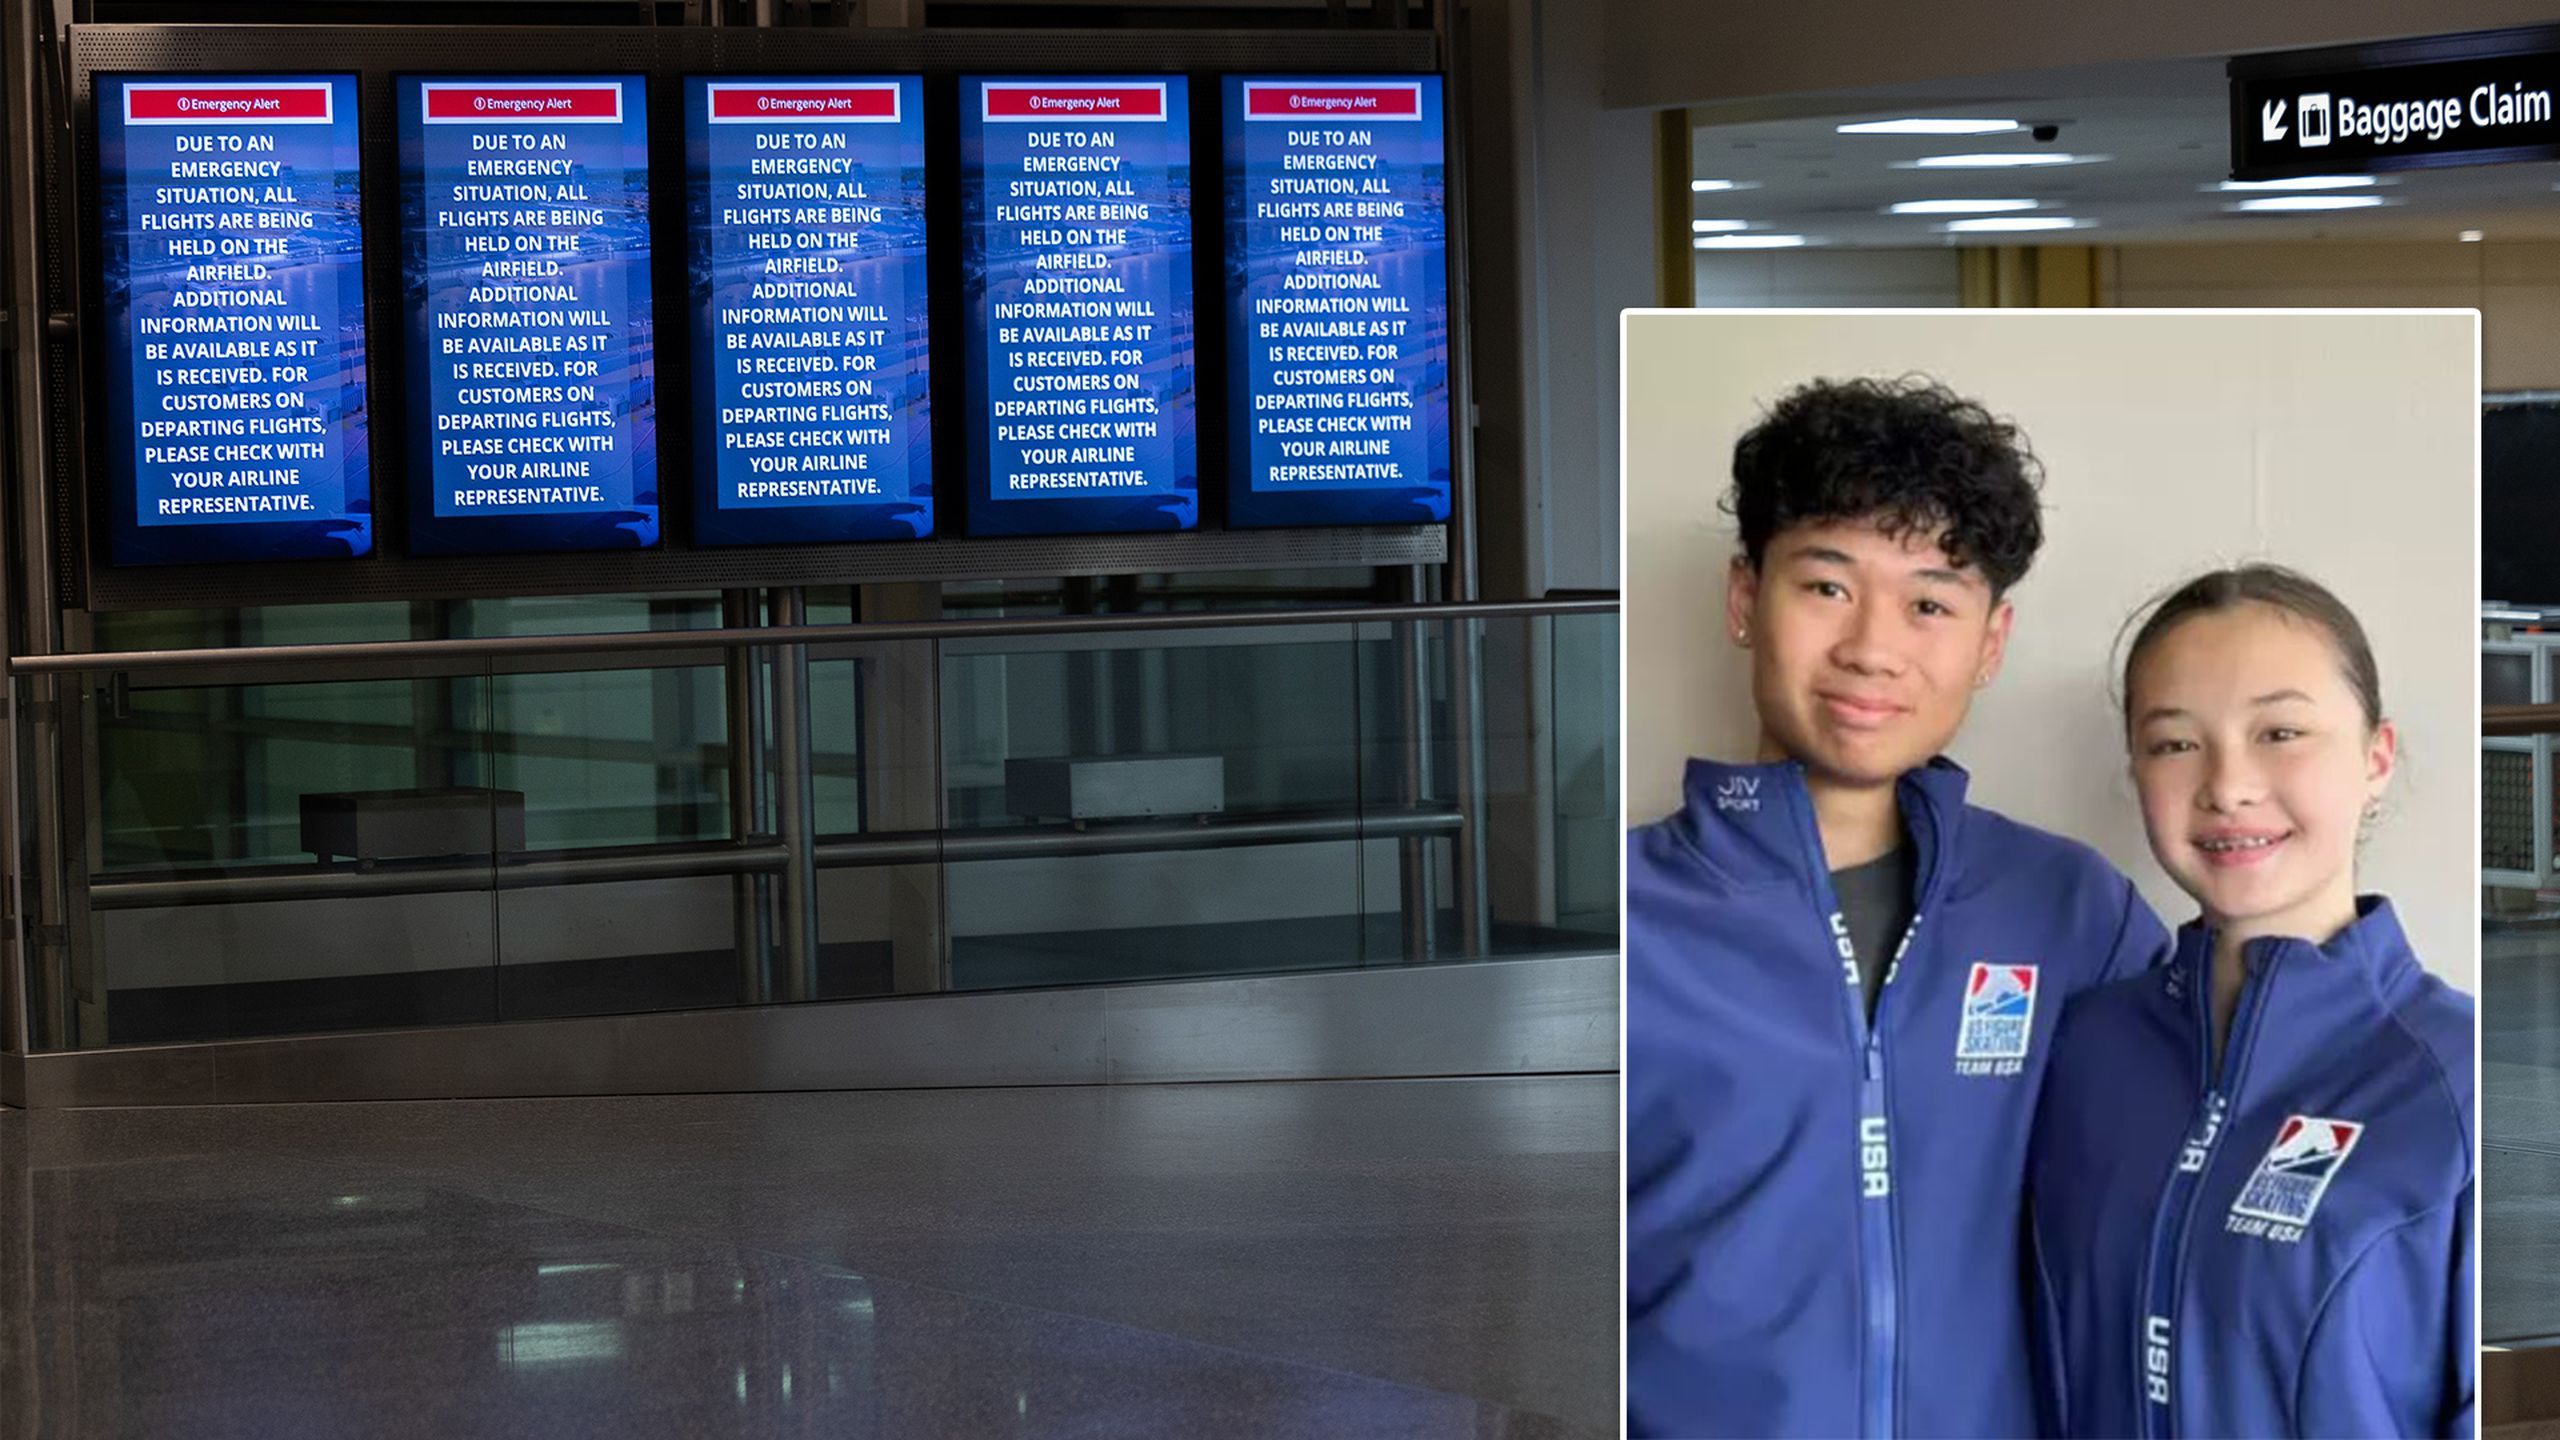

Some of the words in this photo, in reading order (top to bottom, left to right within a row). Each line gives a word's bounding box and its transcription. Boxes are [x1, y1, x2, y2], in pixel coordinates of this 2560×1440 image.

[191, 98, 252, 113] Emergency
[252, 97, 281, 110] Alert
[487, 98, 546, 113] Emergency
[546, 97, 572, 109] Alert
[770, 97, 827, 112] Emergency
[827, 97, 852, 109] Alert
[1041, 96, 1096, 111] Emergency
[1096, 96, 1121, 109] Alert
[1301, 96, 1354, 110] Emergency
[1353, 96, 1377, 108] Alert
[2338, 97, 2462, 145] Baggage
[2469, 81, 2551, 127] Claim
[176, 135, 214, 152] DUE
[217, 135, 243, 152] TO
[246, 135, 274, 152] AN
[472, 134, 508, 150] DUE
[511, 134, 536, 150] TO
[540, 134, 566, 150] AN
[171, 160, 282, 178] EMERGENCY
[467, 159, 573, 176] EMERGENCY
[751, 158, 853, 175] EMERGENCY
[1023, 156, 1121, 172] EMERGENCY
[1283, 154, 1377, 170] EMERGENCY
[156, 187, 260, 205] SITUATION,
[263, 186, 298, 203] ALL
[453, 185, 552, 203] SITUATION,
[556, 184, 588, 201] ALL
[737, 183, 833, 201] SITUATION,
[836, 182, 867, 199] ALL
[1010, 180, 1101, 198] SITUATION,
[1105, 180, 1135, 196] ALL
[1271, 178, 1359, 195] SITUATION,
[1362, 178, 1391, 194] ALL
[439, 210, 509, 227] FLIGHTS
[513, 210, 547, 226] ARE
[551, 208, 604, 226] BEING
[724, 208, 791, 225] FLIGHTS
[794, 207, 827, 224] ARE
[831, 206, 882, 223] BEING
[997, 205, 1062, 221] FLIGHTS
[1064, 205, 1096, 221] ARE
[1100, 203, 1149, 220] BEING
[1258, 202, 1321, 218] FLIGHTS
[1323, 202, 1354, 218] ARE
[1357, 201, 1404, 218] BEING
[141, 213, 215, 230] FLIGHTS
[218, 212, 254, 229] ARE
[258, 213, 313, 229] BEING
[169, 239, 216, 256] HELD
[220, 238, 249, 255] ON
[253, 238, 289, 257] THE
[465, 236, 510, 252] HELD
[515, 235, 542, 252] ON
[546, 234, 580, 253] THE
[764, 257, 844, 274] AIRFIELD.
[1036, 253, 1112, 270] AIRFIELD.
[1295, 249, 1369, 266] AIRFIELD.
[186, 264, 273, 281] AIRFIELD.
[481, 260, 564, 277] AIRFIELD.
[752, 281, 857, 299] ADDITIONAL
[1024, 277, 1125, 294] ADDITIONAL
[1283, 273, 1381, 290] ADDITIONAL
[172, 289, 288, 308] ADDITIONAL
[469, 285, 578, 303] ADDITIONAL
[995, 301, 1112, 319] INFORMATION
[1115, 301, 1155, 317] WILL
[1256, 297, 1369, 314] INFORMATION
[1371, 296, 1410, 313] WILL
[140, 315, 273, 334] INFORMATION
[276, 314, 321, 331] WILL
[438, 310, 564, 329] INFORMATION
[567, 310, 611, 326] WILL
[722, 306, 843, 325] INFORMATION
[847, 305, 888, 322] WILL
[145, 343, 168, 360] BE
[171, 341, 270, 359] AVAILABLE
[274, 340, 297, 357] AS
[301, 340, 318, 356] IT
[442, 338, 463, 354] BE
[467, 336, 562, 354] AVAILABLE
[565, 335, 588, 352] AS
[592, 335, 608, 351] IT
[157, 369, 173, 386] IS
[177, 367, 268, 385] RECEIVED.
[272, 366, 309, 383] FOR
[453, 363, 469, 379] IS
[473, 361, 559, 379] RECEIVED.
[564, 360, 599, 377] FOR
[1273, 368, 1367, 386] CUSTOMERS
[1369, 368, 1395, 384] ON
[741, 380, 842, 399] CUSTOMERS
[846, 379, 872, 396] ON
[1013, 374, 1110, 392] CUSTOMERS
[1113, 374, 1139, 390] ON
[162, 392, 272, 411] CUSTOMERS
[275, 391, 304, 409] ON
[458, 386, 563, 405] CUSTOMERS
[567, 385, 594, 402] ON
[1255, 393, 1344, 410] DEPARTING
[1347, 391, 1414, 409] FLIGHTS,
[722, 406, 817, 424] DEPARTING
[822, 404, 893, 422] FLIGHTS,
[995, 399, 1086, 417] DEPARTING
[1090, 397, 1159, 415] FLIGHTS,
[141, 419, 245, 438] DEPARTING
[249, 417, 327, 435] FLIGHTS,
[438, 412, 537, 431] DEPARTING
[542, 410, 616, 428] FLIGHTS,
[1259, 417, 1313, 434] PLEASE
[1317, 416, 1368, 433] CHECK
[1370, 415, 1411, 431] WITH
[726, 431, 785, 449] PLEASE
[789, 430, 844, 447] CHECK
[846, 428, 890, 445] WITH
[998, 424, 1055, 441] PLEASE
[1058, 423, 1112, 440] CHECK
[1114, 421, 1157, 438] WITH
[145, 446, 209, 463] PLEASE
[214, 444, 273, 461] CHECK
[276, 442, 324, 460] WITH
[442, 438, 503, 456] PLEASE
[507, 437, 565, 454] CHECK
[567, 435, 614, 452] WITH
[749, 456, 798, 473] YOUR
[801, 454, 868, 471] AIRLINE
[1021, 448, 1068, 465] YOUR
[1070, 446, 1135, 463] AIRLINE
[171, 471, 224, 488] YOUR
[227, 469, 300, 487] AIRLINE
[467, 463, 518, 480] YOUR
[521, 461, 590, 479] AIRLINE
[1009, 470, 1148, 489] REPRESENTATIVE.
[1270, 463, 1403, 481] REPRESENTATIVE.
[454, 486, 604, 506] REPRESENTATIVE.
[738, 478, 881, 498] REPRESENTATIVE.
[158, 494, 315, 515] REPRESENTATIVE.
[1860, 1117, 1889, 1198] USA
[2224, 1214, 2270, 1236] TEAM
[2269, 1222, 2304, 1242] USA
[2147, 1315, 2170, 1405] USA
